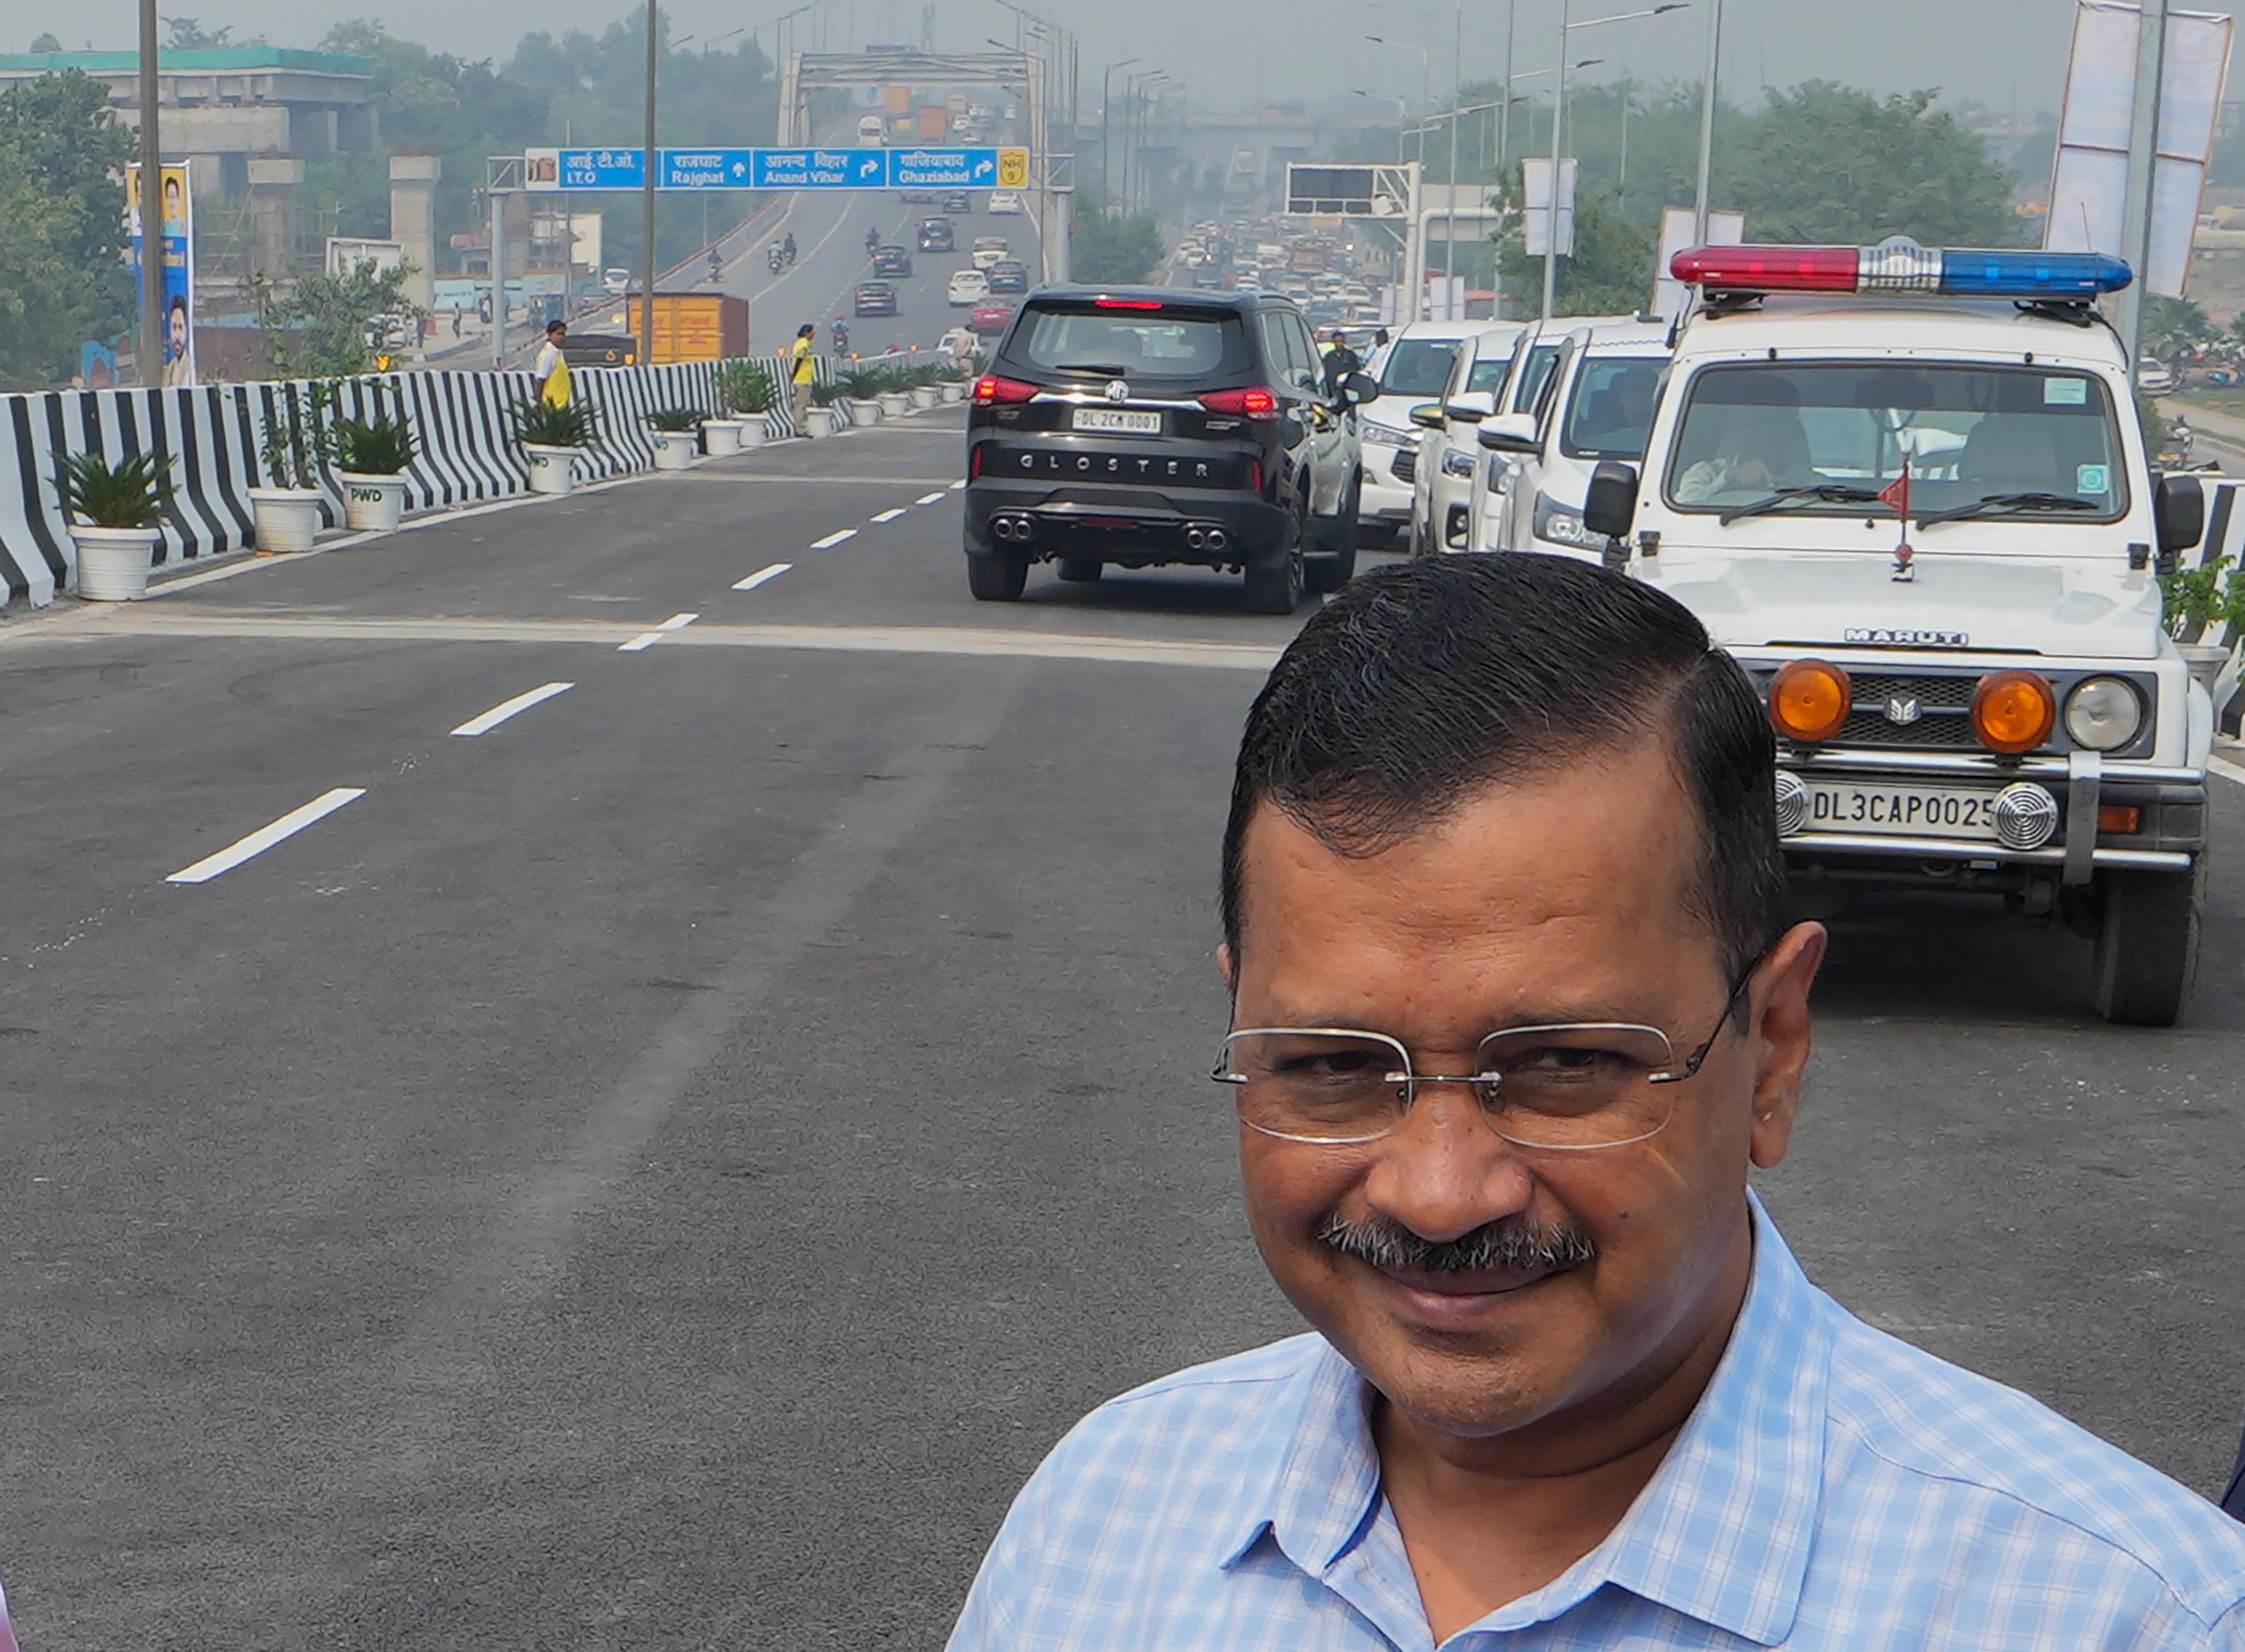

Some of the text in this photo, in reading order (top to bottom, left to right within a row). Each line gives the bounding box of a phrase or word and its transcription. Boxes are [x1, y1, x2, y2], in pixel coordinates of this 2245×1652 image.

[1003, 159, 1021, 168] NH
[672, 170, 724, 186] Rajghat
[764, 171, 846, 183] Anand Vihar
[898, 170, 970, 183] Ghaziabad
[1082, 411, 1096, 426] DL
[1127, 414, 1158, 429] 0001
[1020, 454, 1207, 477] GLOSTER
[351, 487, 382, 502] PWD
[1844, 628, 1969, 647] MARUTI
